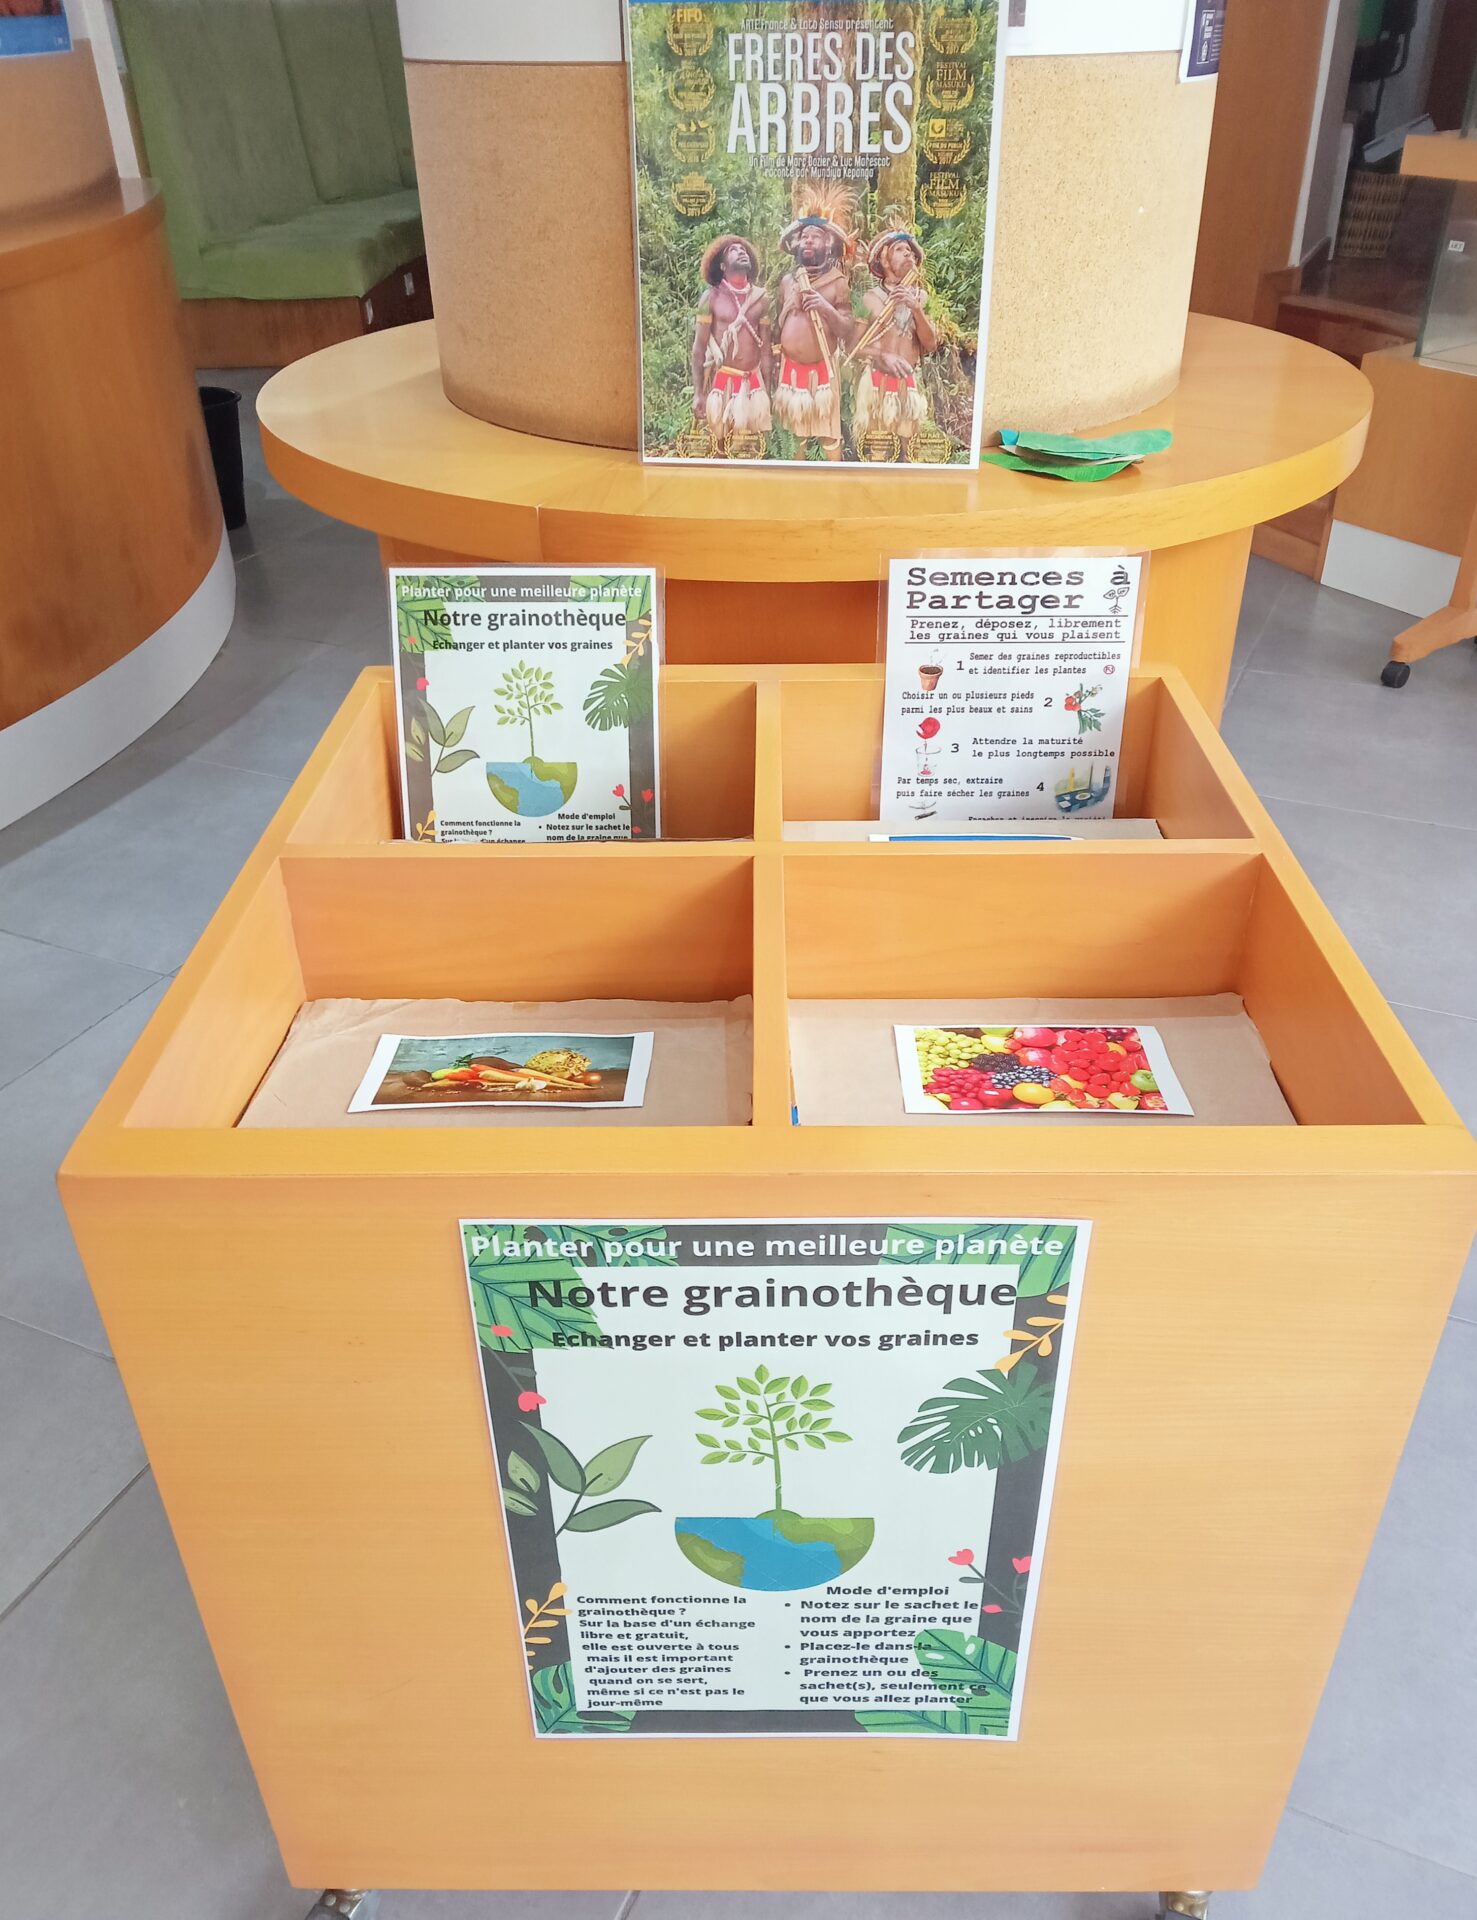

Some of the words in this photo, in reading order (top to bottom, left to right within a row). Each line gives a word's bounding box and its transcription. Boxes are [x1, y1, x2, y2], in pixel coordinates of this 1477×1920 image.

[729, 31, 844, 82] FRERES
[855, 31, 916, 81] DES
[936, 69, 967, 81] FILM
[727, 82, 913, 154] ARBRES
[929, 179, 960, 190] FILM
[907, 567, 1083, 586] Semences
[1111, 565, 1130, 585] à
[401, 586, 451, 597] Planter
[454, 587, 487, 601] pour
[491, 587, 516, 597] une
[520, 584, 586, 597] meilleure
[907, 591, 1083, 614] Partager
[424, 609, 481, 626] Notre
[487, 609, 626, 631] grainothèque
[910, 619, 965, 631] Prenez,
[975, 619, 1037, 631] déposez,
[1049, 618, 1120, 628] librement
[910, 631, 930, 640] les
[938, 631, 989, 642] graines
[996, 631, 1018, 641] qui
[1061, 630, 1121, 641] plaisent
[433, 639, 485, 651] Echanger
[488, 641, 500, 650] et
[503, 639, 545, 652] planter
[548, 641, 568, 650] vos
[571, 639, 613, 651] graines
[970, 653, 993, 661] Semer
[998, 652, 1012, 661] des
[1017, 654, 1049, 663] graines
[1055, 652, 1120, 662] reproductibles
[957, 661, 964, 670] 1
[969, 667, 978, 675] et
[983, 666, 1030, 675] identifier
[1035, 666, 1048, 675] les
[1053, 666, 1086, 676] plantes
[902, 691, 934, 700] Choisir
[965, 691, 1007, 701] plusieurs
[1011, 691, 1034, 701] pieds
[1044, 697, 1052, 707] 2
[901, 707, 924, 716] parmi
[929, 705, 942, 714] les
[946, 705, 965, 715] plus
[969, 705, 992, 714] beaux
[997, 706, 1006, 714] et
[1023, 737, 1033, 745] la
[1038, 737, 1083, 745] maturité
[951, 743, 959, 753] 3
[972, 750, 983, 758] le
[988, 750, 1010, 759] plus
[1016, 750, 1065, 759] longtemps
[1070, 749, 1115, 759] possible
[897, 777, 911, 785] Par
[916, 777, 938, 786] temps
[966, 777, 1003, 785] extraire
[1036, 782, 1044, 791] 4
[896, 791, 915, 800] puis
[920, 790, 942, 798] faire
[979, 789, 993, 798] les
[997, 790, 1029, 799] graines
[557, 813, 579, 821] Mode
[440, 820, 473, 828] Comment
[475, 820, 511, 828] fonctionne
[546, 824, 569, 832] Notez
[595, 823, 620, 832] sachet
[440, 829, 487, 838] grainothèque
[471, 1237, 593, 1258] Planter
[603, 1239, 681, 1263] pour
[693, 1240, 754, 1257] une
[765, 1234, 924, 1257] meilleure
[935, 1235, 1064, 1260] planète
[527, 1280, 668, 1308] Notre
[683, 1277, 1017, 1316] grainothèque
[553, 1332, 675, 1350] Echanger
[683, 1334, 710, 1347] et
[719, 1331, 818, 1351] planter
[825, 1333, 871, 1347] vos
[877, 1330, 979, 1350] graines
[827, 1586, 872, 1595] Mode
[877, 1586, 949, 1597] d'emploi
[577, 1596, 647, 1605] Comment
[651, 1596, 729, 1604] fonctionne
[734, 1596, 746, 1604] la
[801, 1601, 849, 1610] Notez
[885, 1600, 899, 1609] le
[904, 1601, 959, 1610] sachet
[964, 1601, 978, 1610] le
[578, 1608, 675, 1617] grainothèque
[580, 1620, 603, 1628] Sur
[607, 1620, 619, 1628] la
[624, 1620, 656, 1628] base
[661, 1620, 691, 1628] d'un
[696, 1620, 755, 1629] échange
[801, 1616, 836, 1624] nom
[842, 1615, 861, 1624] de
[866, 1615, 879, 1624] la
[884, 1615, 937, 1625] graine
[942, 1617, 972, 1626] que
[581, 1631, 613, 1640] libre
[635, 1631, 688, 1641] gratuit,
[800, 1629, 838, 1638] vous
[843, 1629, 916, 1639] apportez
[582, 1643, 607, 1651] elle
[611, 1644, 633, 1652] est
[696, 1643, 704, 1651] à
[801, 1642, 870, 1651] Placez-le
[587, 1655, 620, 1663] mais
[624, 1655, 632, 1663] il
[662, 1655, 733, 1664] important
[800, 1655, 908, 1666] grainothèque
[585, 1666, 648, 1675] d'ajouter
[680, 1665, 731, 1674] graines
[804, 1669, 857, 1677] Prenez
[911, 1669, 938, 1678] des
[590, 1677, 632, 1686] quand
[677, 1678, 707, 1686] sert,
[800, 1682, 875, 1691] sachet(s),
[880, 1682, 964, 1691] seulement
[587, 1688, 630, 1696] même
[634, 1688, 644, 1696] si
[668, 1688, 701, 1696] n'est
[733, 1688, 744, 1696] le
[587, 1699, 663, 1708] jour-même
[800, 1696, 828, 1705] que
[874, 1695, 910, 1703] allez
[915, 1694, 972, 1704] planter
